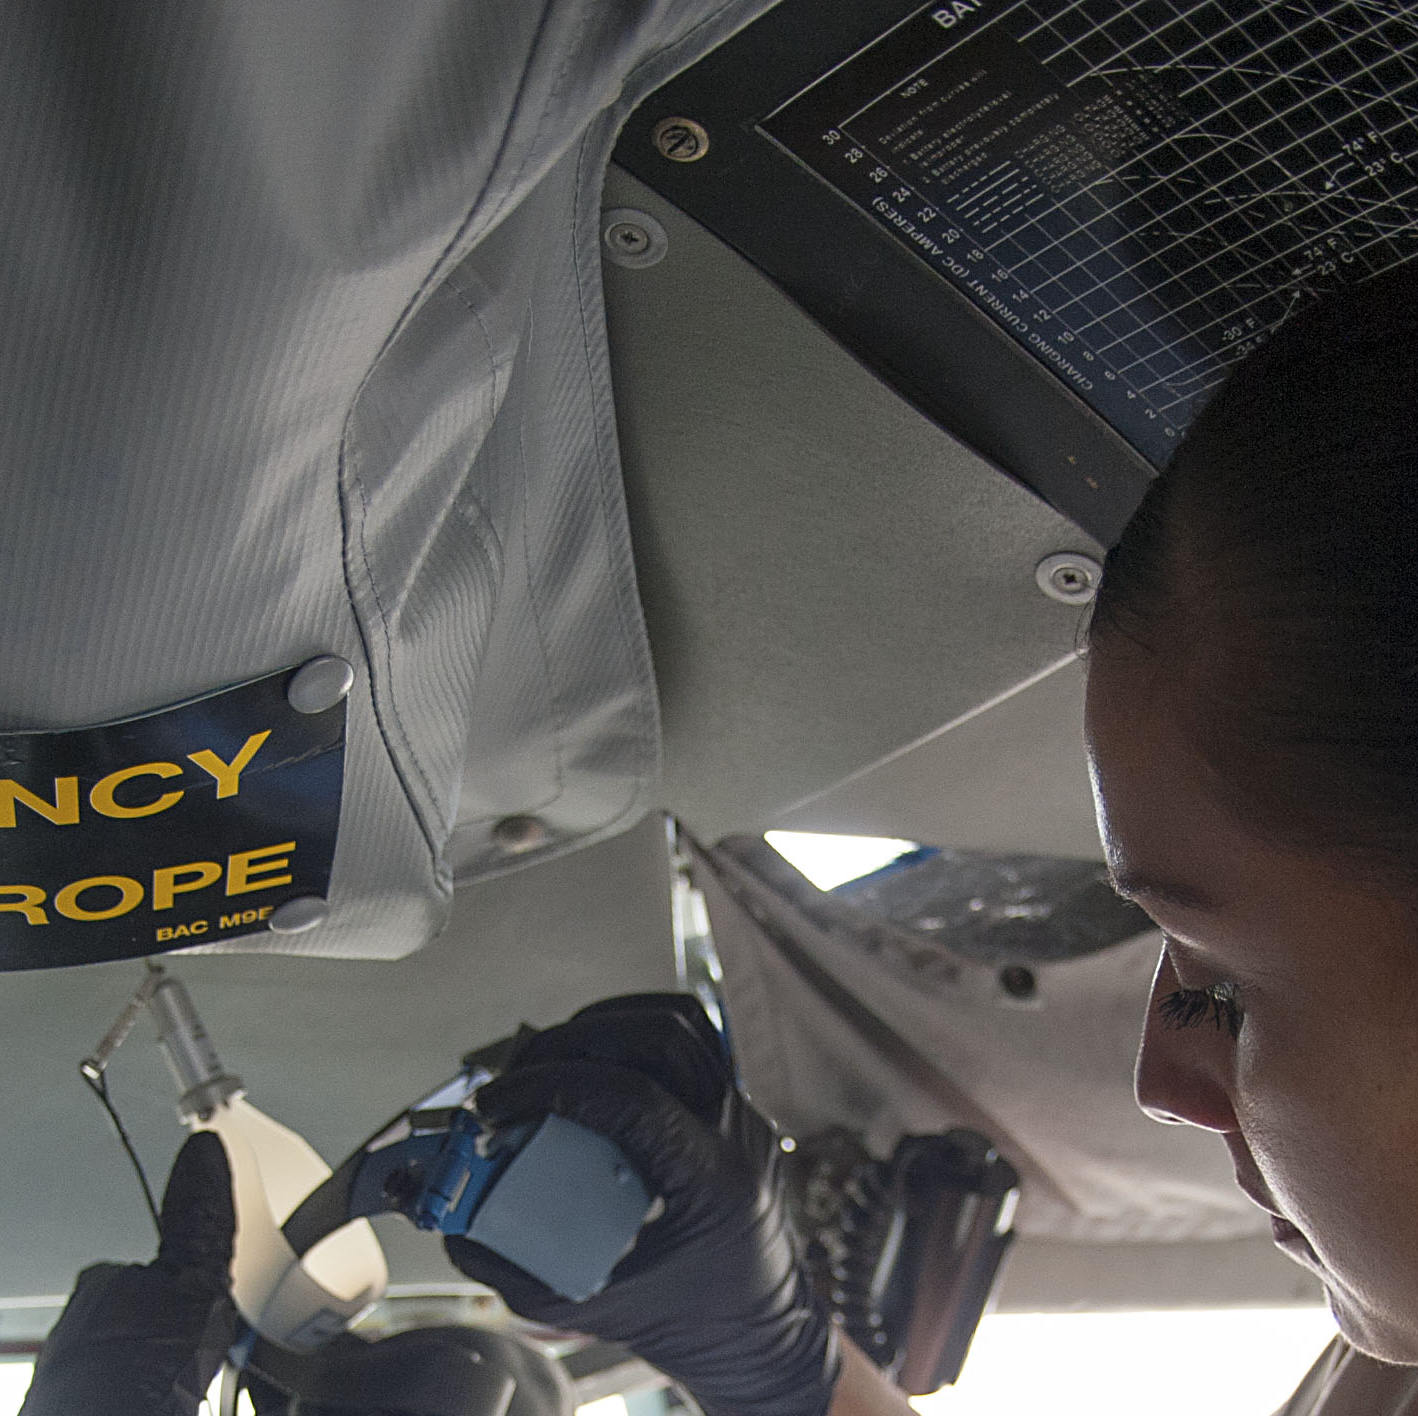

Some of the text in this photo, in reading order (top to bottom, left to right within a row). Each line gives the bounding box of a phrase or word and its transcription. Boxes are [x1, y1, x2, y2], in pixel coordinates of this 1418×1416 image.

[900, 77, 929, 100] NOTE
[871, 195, 943, 257] AMPERES)
[967, 279, 1028, 334] CURRENT
[1027, 331, 1093, 392] CHARGING
[155, 919, 209, 942] BAC
